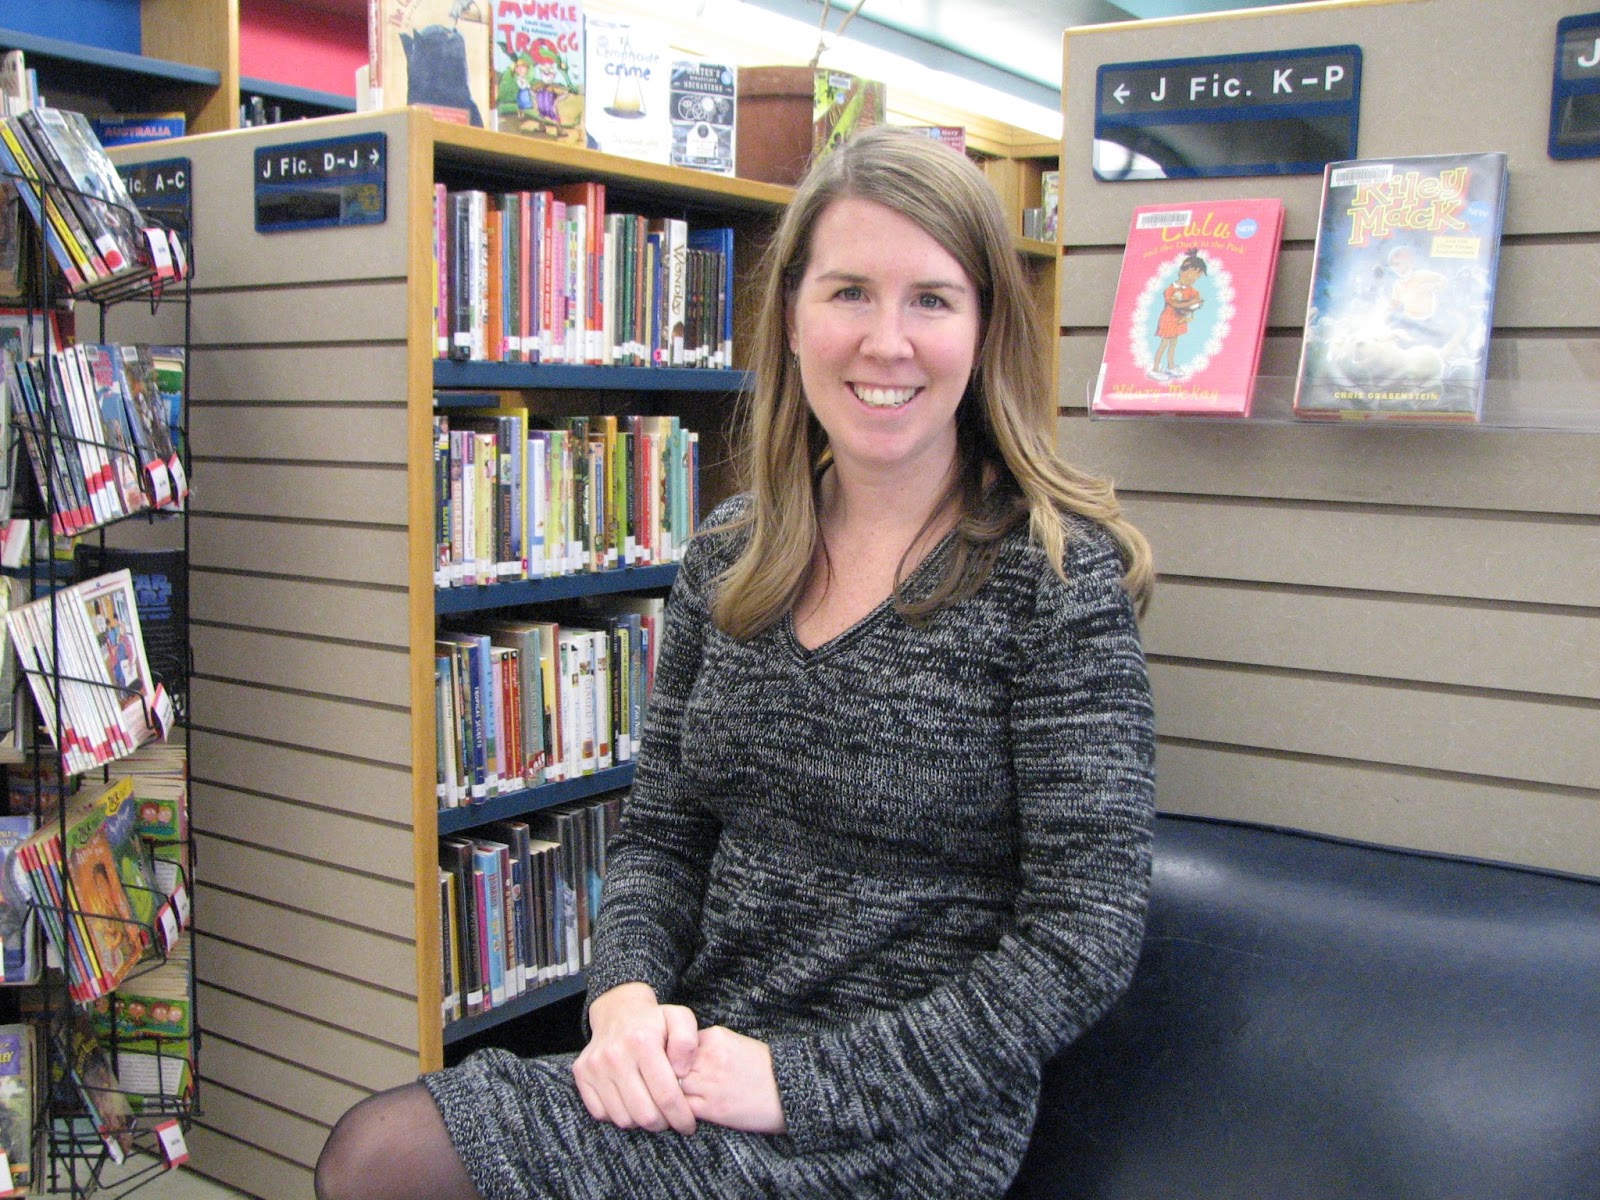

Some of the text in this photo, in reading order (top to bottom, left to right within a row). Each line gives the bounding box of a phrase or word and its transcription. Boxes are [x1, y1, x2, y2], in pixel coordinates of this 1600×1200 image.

[498, 0, 577, 22] MUNCLE
[497, 24, 579, 64] TROGG
[1577, 38, 1600, 68] J
[1150, 65, 1345, 102] J Fic. K-P
[104, 126, 171, 137] AUSTRALIA
[263, 149, 358, 179] J Fic. D-J
[155, 171, 185, 191] A-C
[1350, 166, 1469, 207] Riley
[1346, 200, 1468, 246] Mack
[1334, 391, 1440, 401] CHRIS GRABENSTEIN
[503, 494, 512, 533] Hatching
[455, 534, 464, 554] BOY
